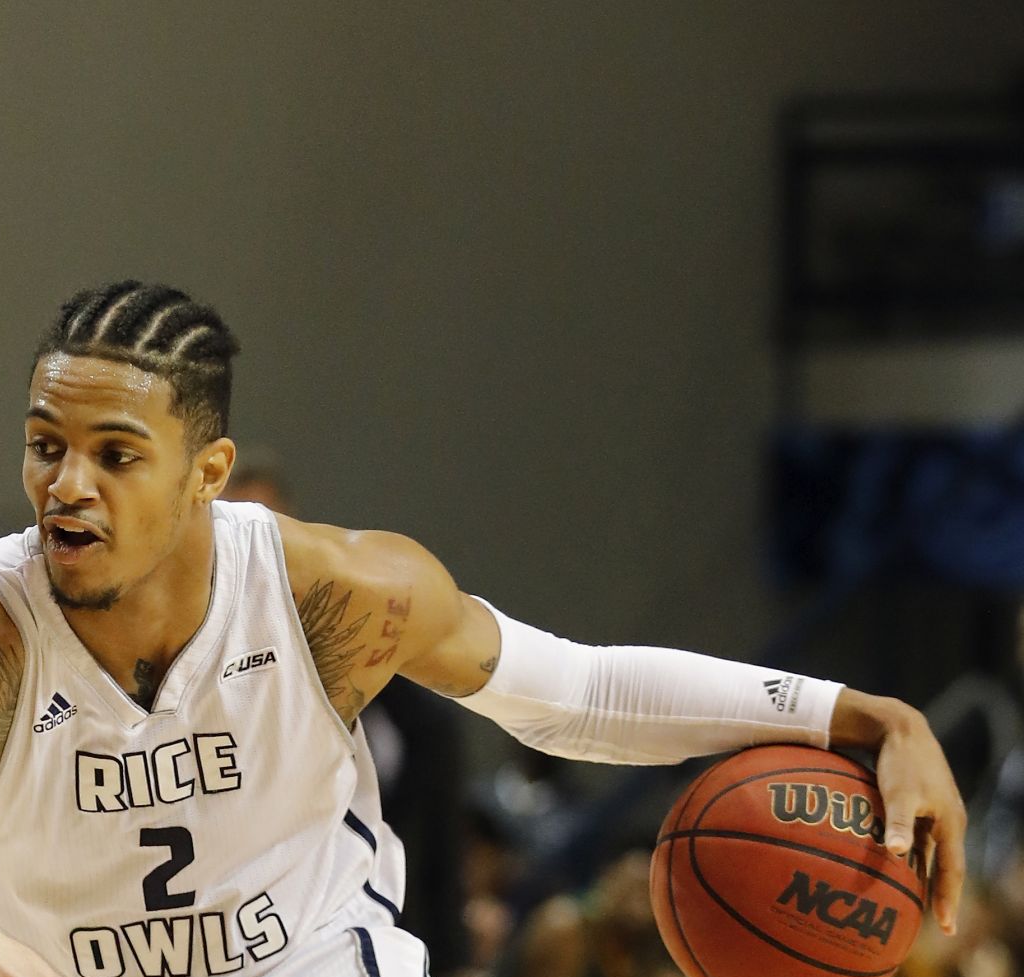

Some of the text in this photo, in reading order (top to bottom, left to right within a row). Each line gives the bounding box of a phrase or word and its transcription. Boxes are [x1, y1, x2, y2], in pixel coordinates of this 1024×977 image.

[33, 705, 78, 734] adidas
[75, 732, 242, 813] RICE
[139, 826, 197, 912] 2
[777, 870, 898, 945] NCAA
